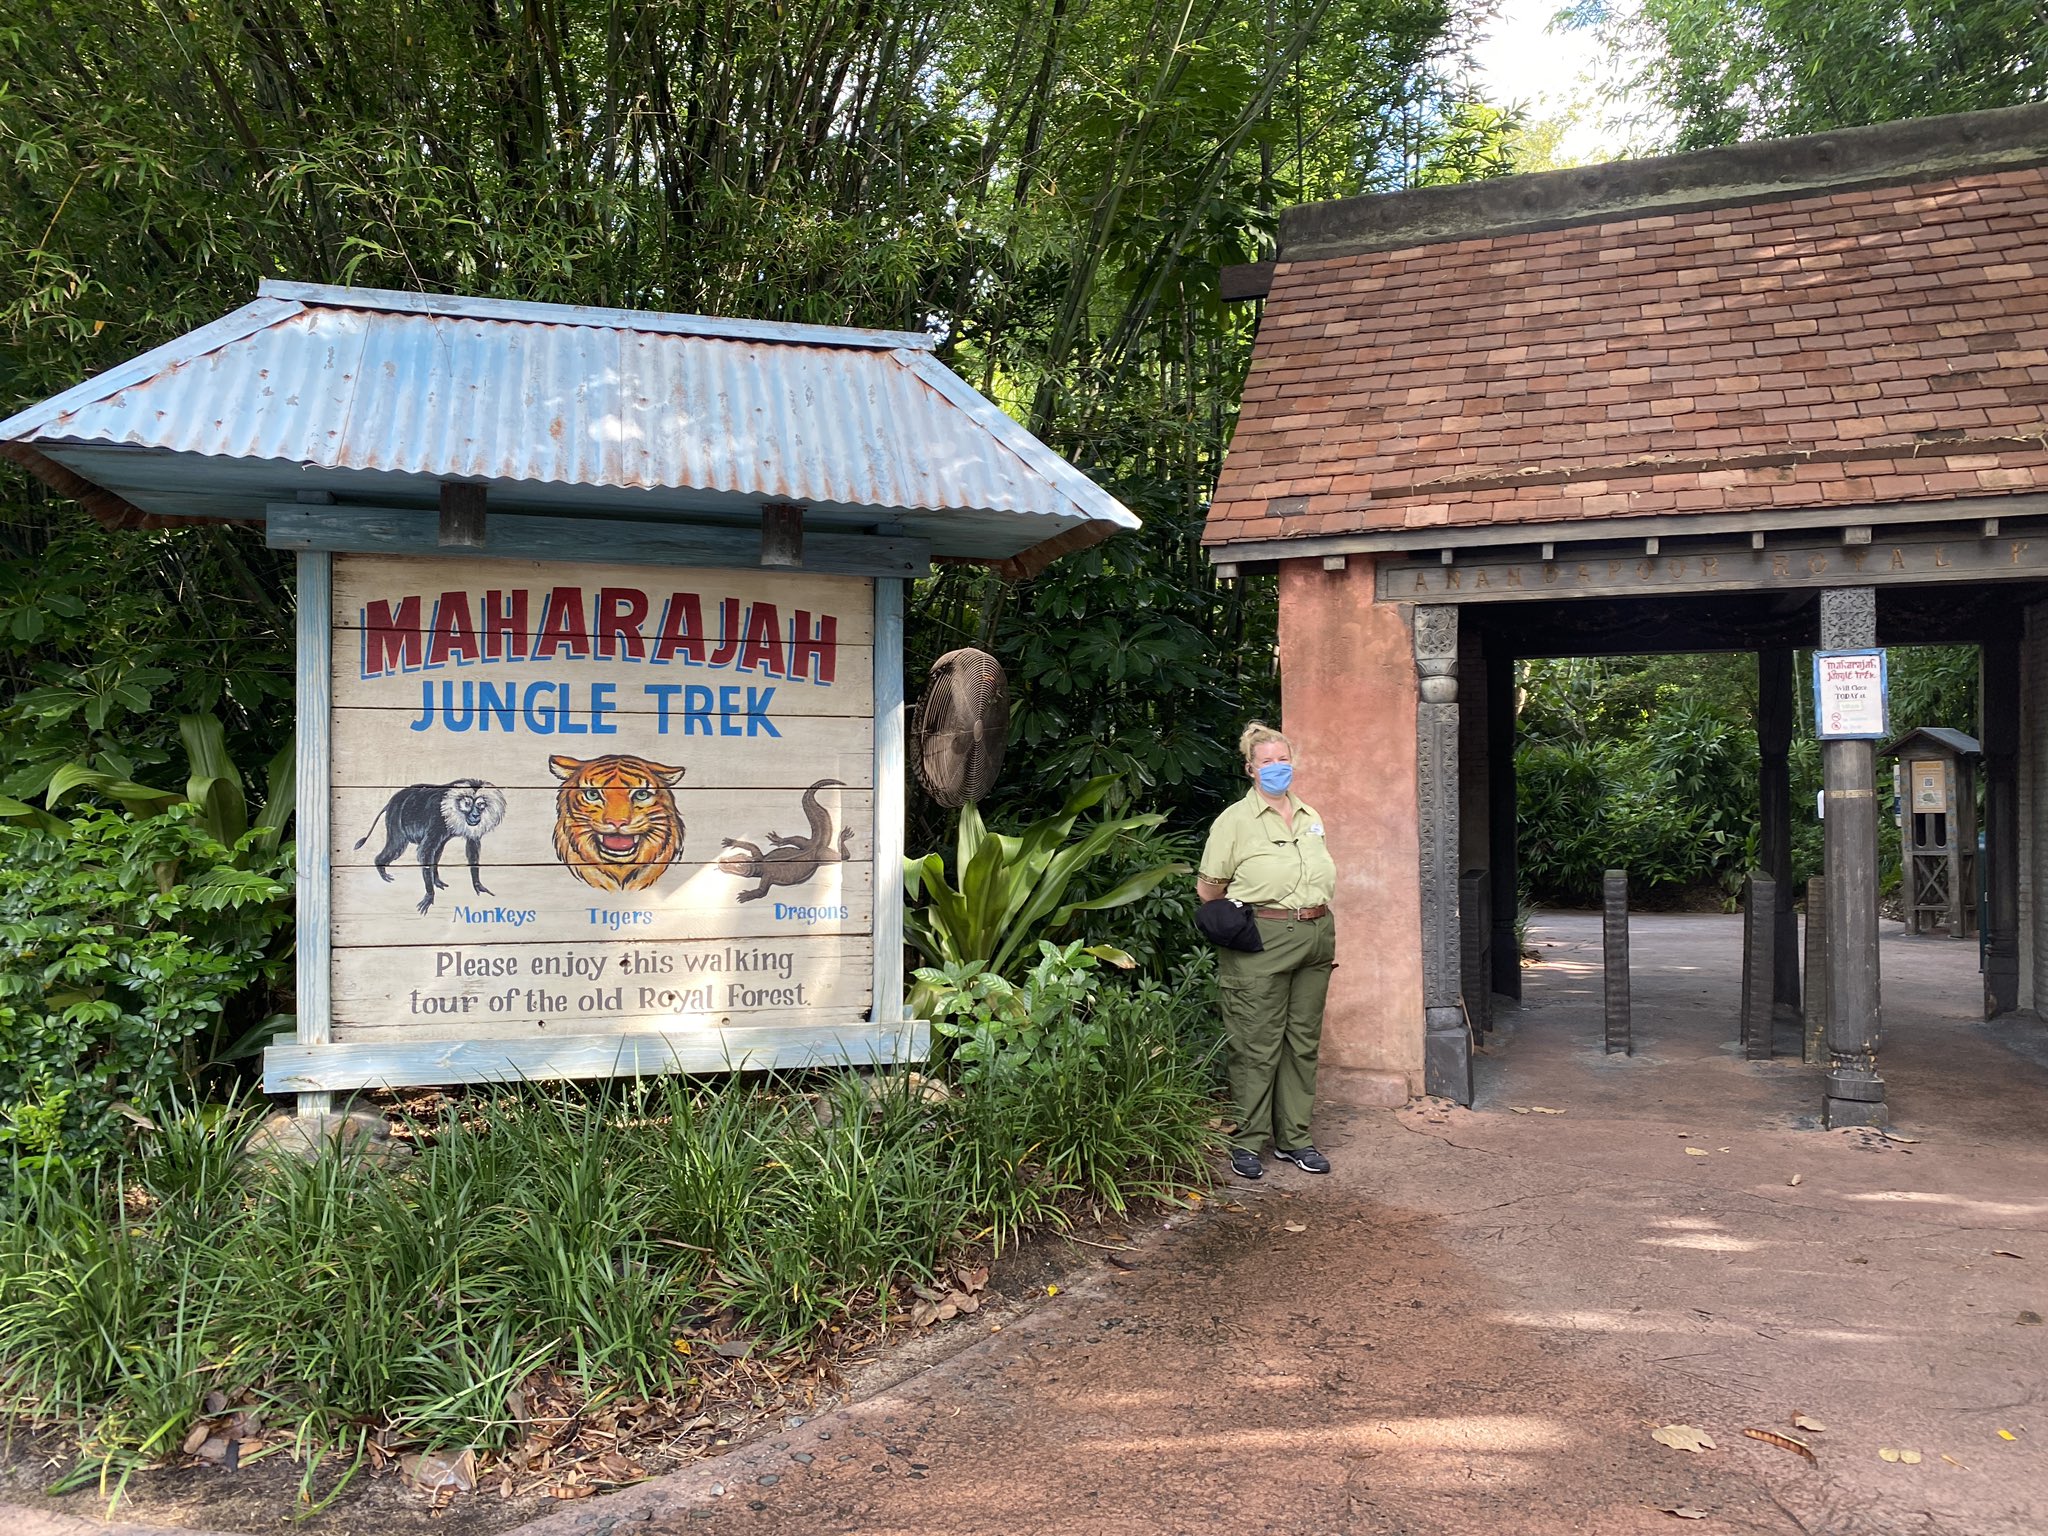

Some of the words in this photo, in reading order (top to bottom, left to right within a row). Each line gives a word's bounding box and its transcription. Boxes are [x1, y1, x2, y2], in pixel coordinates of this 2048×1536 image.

[1772, 544, 1952, 577] ROYAL
[360, 586, 838, 687] MAHARAJAH
[410, 680, 618, 735] JUNGLE
[644, 684, 783, 738] TREK
[585, 907, 653, 931] Tigers
[773, 902, 849, 926] Dragons
[435, 951, 518, 978] Please
[531, 951, 607, 981] enjoy
[619, 950, 674, 976] this
[684, 947, 794, 979] walking
[409, 988, 478, 1015] tour
[489, 987, 521, 1012] of
[524, 988, 568, 1012] the
[578, 986, 623, 1011] old
[638, 984, 714, 1014] Royal
[727, 982, 812, 1008] Forest.
